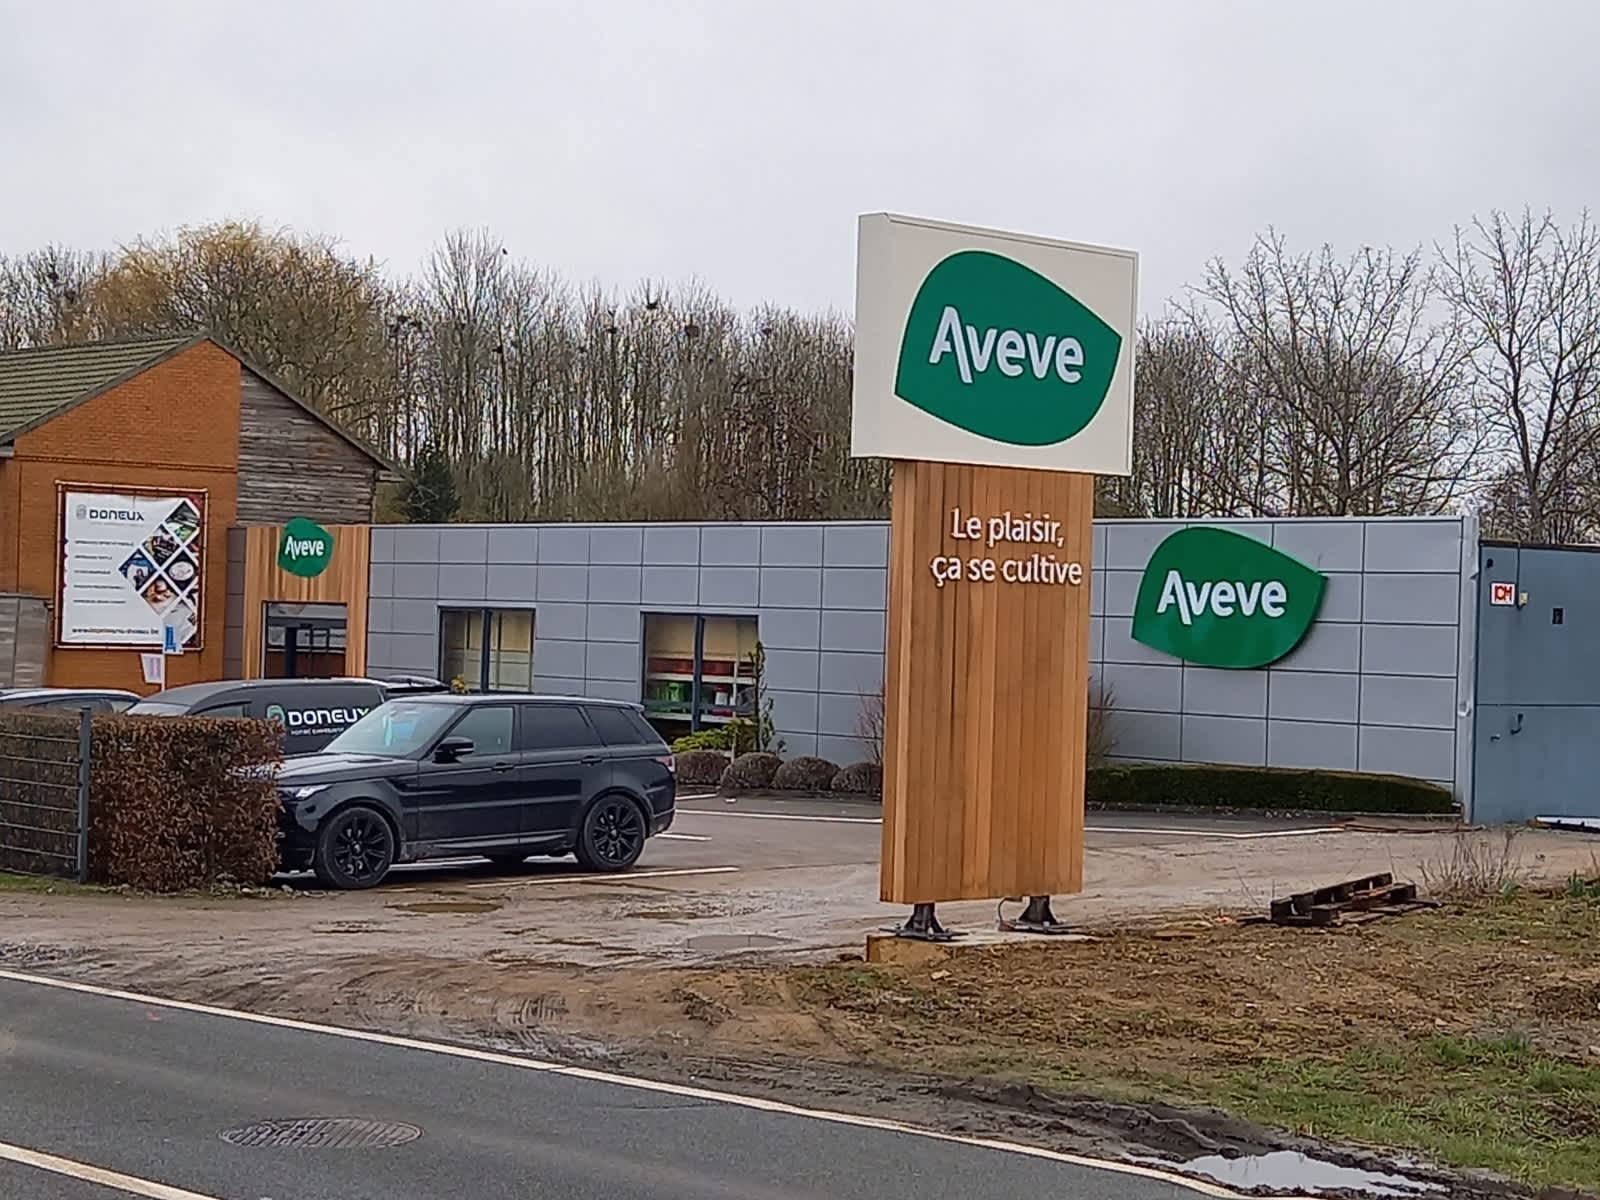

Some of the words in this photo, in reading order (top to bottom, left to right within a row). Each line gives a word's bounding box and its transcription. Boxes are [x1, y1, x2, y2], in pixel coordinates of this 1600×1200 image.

[929, 305, 1084, 384] Aveve
[284, 535, 325, 560] Aveve
[951, 508, 982, 539] Le
[987, 511, 1064, 548] plaisir,
[931, 556, 962, 587] ça
[967, 558, 996, 581] se
[1001, 553, 1083, 585] cultive
[1156, 569, 1288, 625] Aveve
